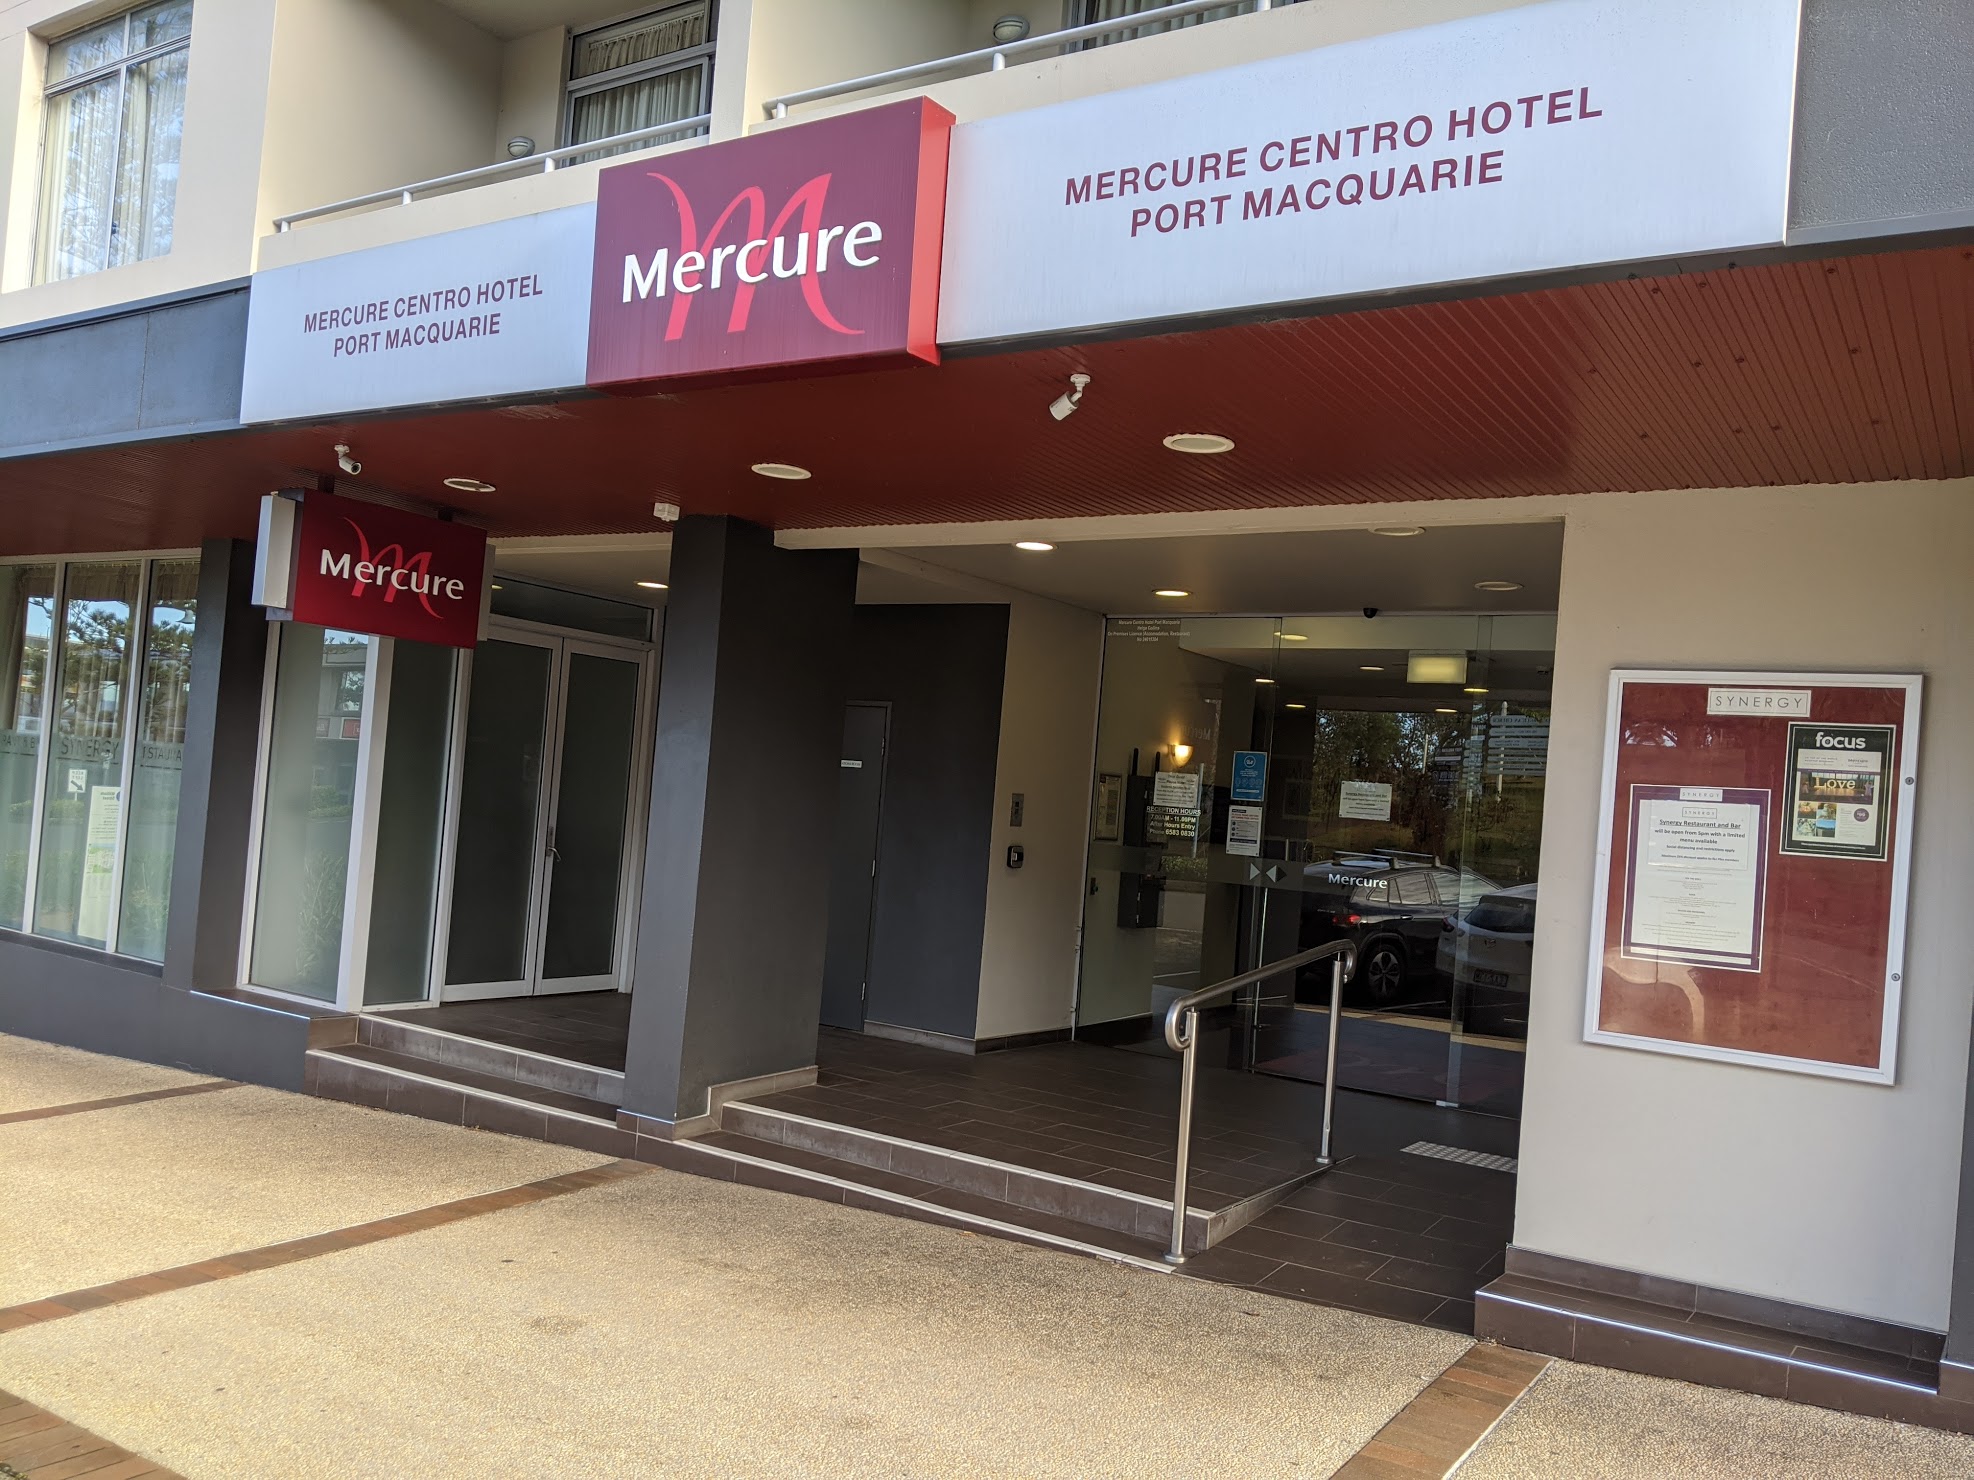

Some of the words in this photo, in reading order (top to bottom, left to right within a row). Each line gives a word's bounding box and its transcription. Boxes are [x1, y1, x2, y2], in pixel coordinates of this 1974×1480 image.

[1064, 146, 1248, 205] MERCURE
[1259, 114, 1433, 172] CENTRO
[1447, 86, 1603, 142] HOTEL
[1129, 194, 1232, 238] PORT
[1241, 149, 1504, 220] MACQUARIE
[622, 219, 883, 304] Mercure
[303, 299, 389, 333] MERCURE
[394, 284, 471, 318] CENTRO
[477, 273, 543, 304] HOTEL
[333, 330, 381, 358] PORT
[385, 312, 500, 350] MACQUARIE
[318, 548, 465, 601] Mercure
[1715, 695, 1802, 709] SYNERGY
[61, 736, 120, 759] SYNERGY
[1815, 731, 1866, 749] focus
[1814, 776, 1855, 791] Love
[1146, 805, 1179, 814] RECEPTION
[1163, 821, 1180, 829] Hours
[1181, 823, 1195, 831] Entry
[1660, 819, 1682, 827] Synergy
[1684, 820, 1716, 828] Restaurant
[1328, 873, 1388, 889] Mercure
